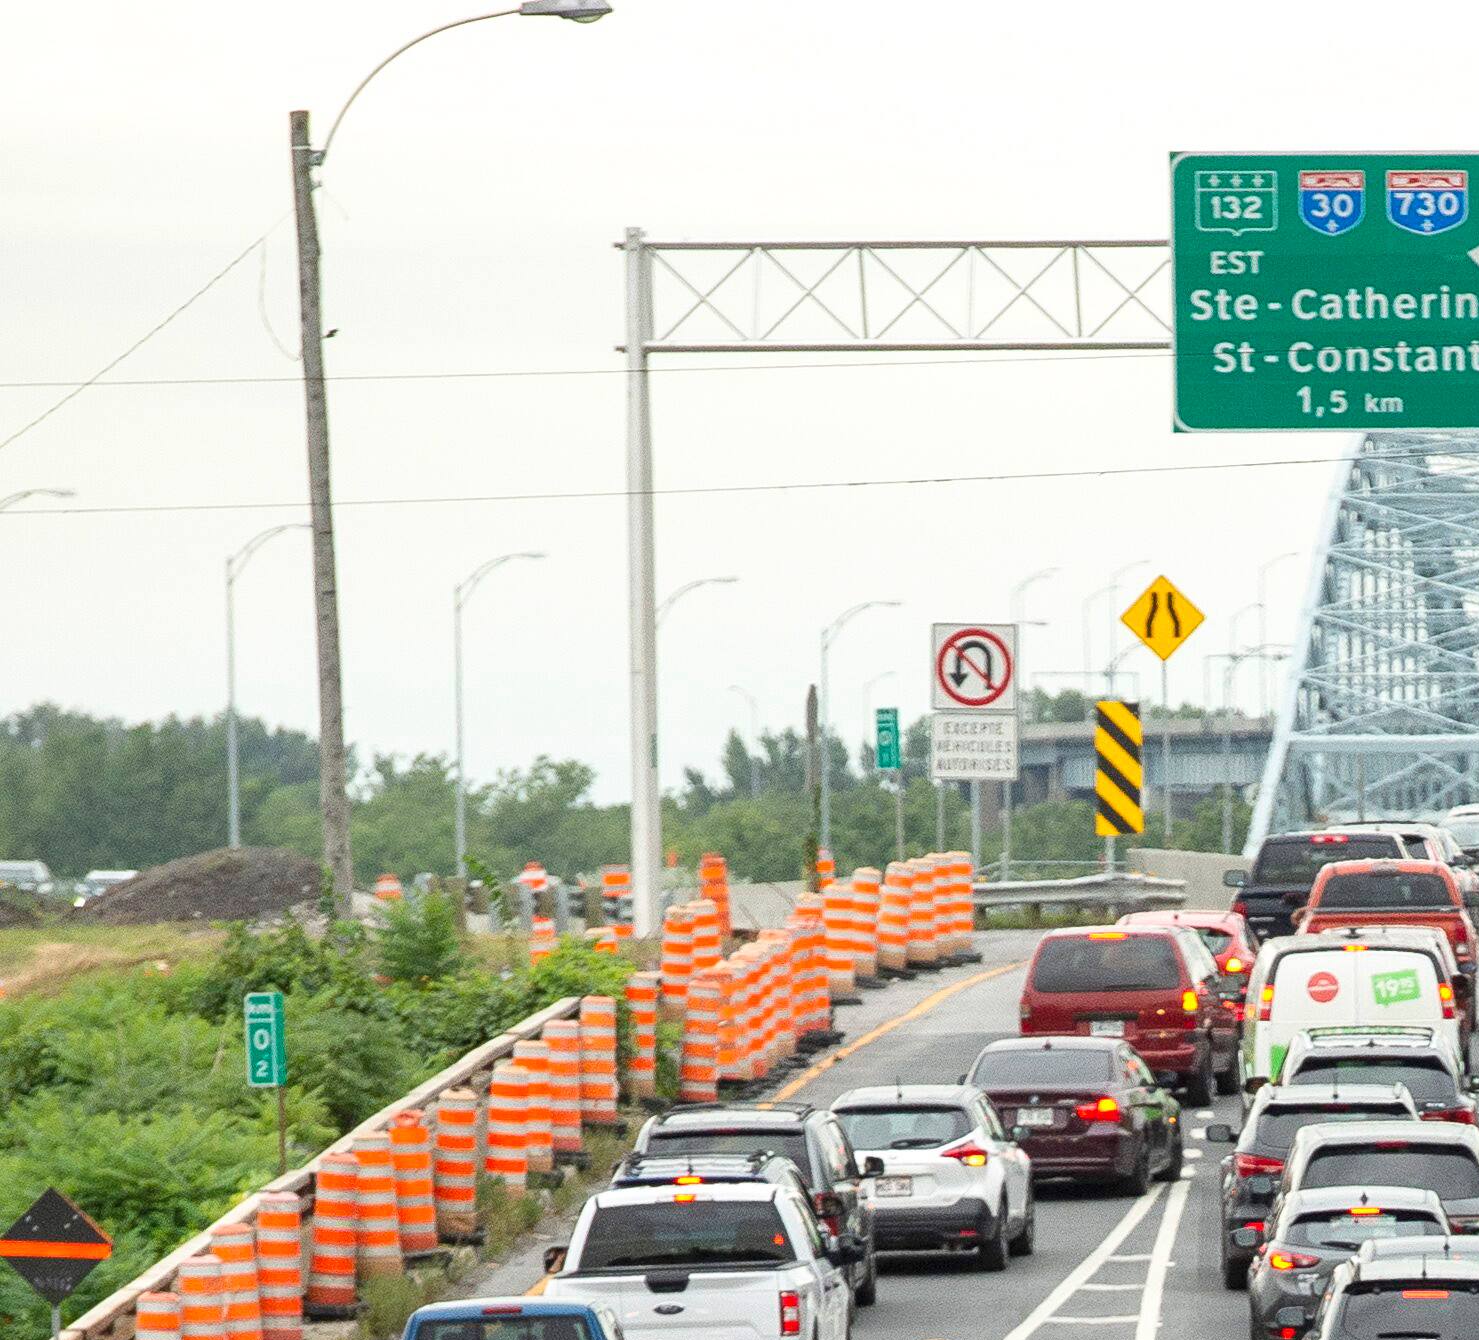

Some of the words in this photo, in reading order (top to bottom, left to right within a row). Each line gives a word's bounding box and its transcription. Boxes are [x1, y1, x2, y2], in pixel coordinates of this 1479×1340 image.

[1210, 195, 1263, 219] 132
[1310, 193, 1354, 218] 30
[1393, 192, 1460, 216] 730
[1210, 250, 1264, 274] EST
[1297, 385, 1348, 417] 1,5
[1364, 393, 1404, 413] km
